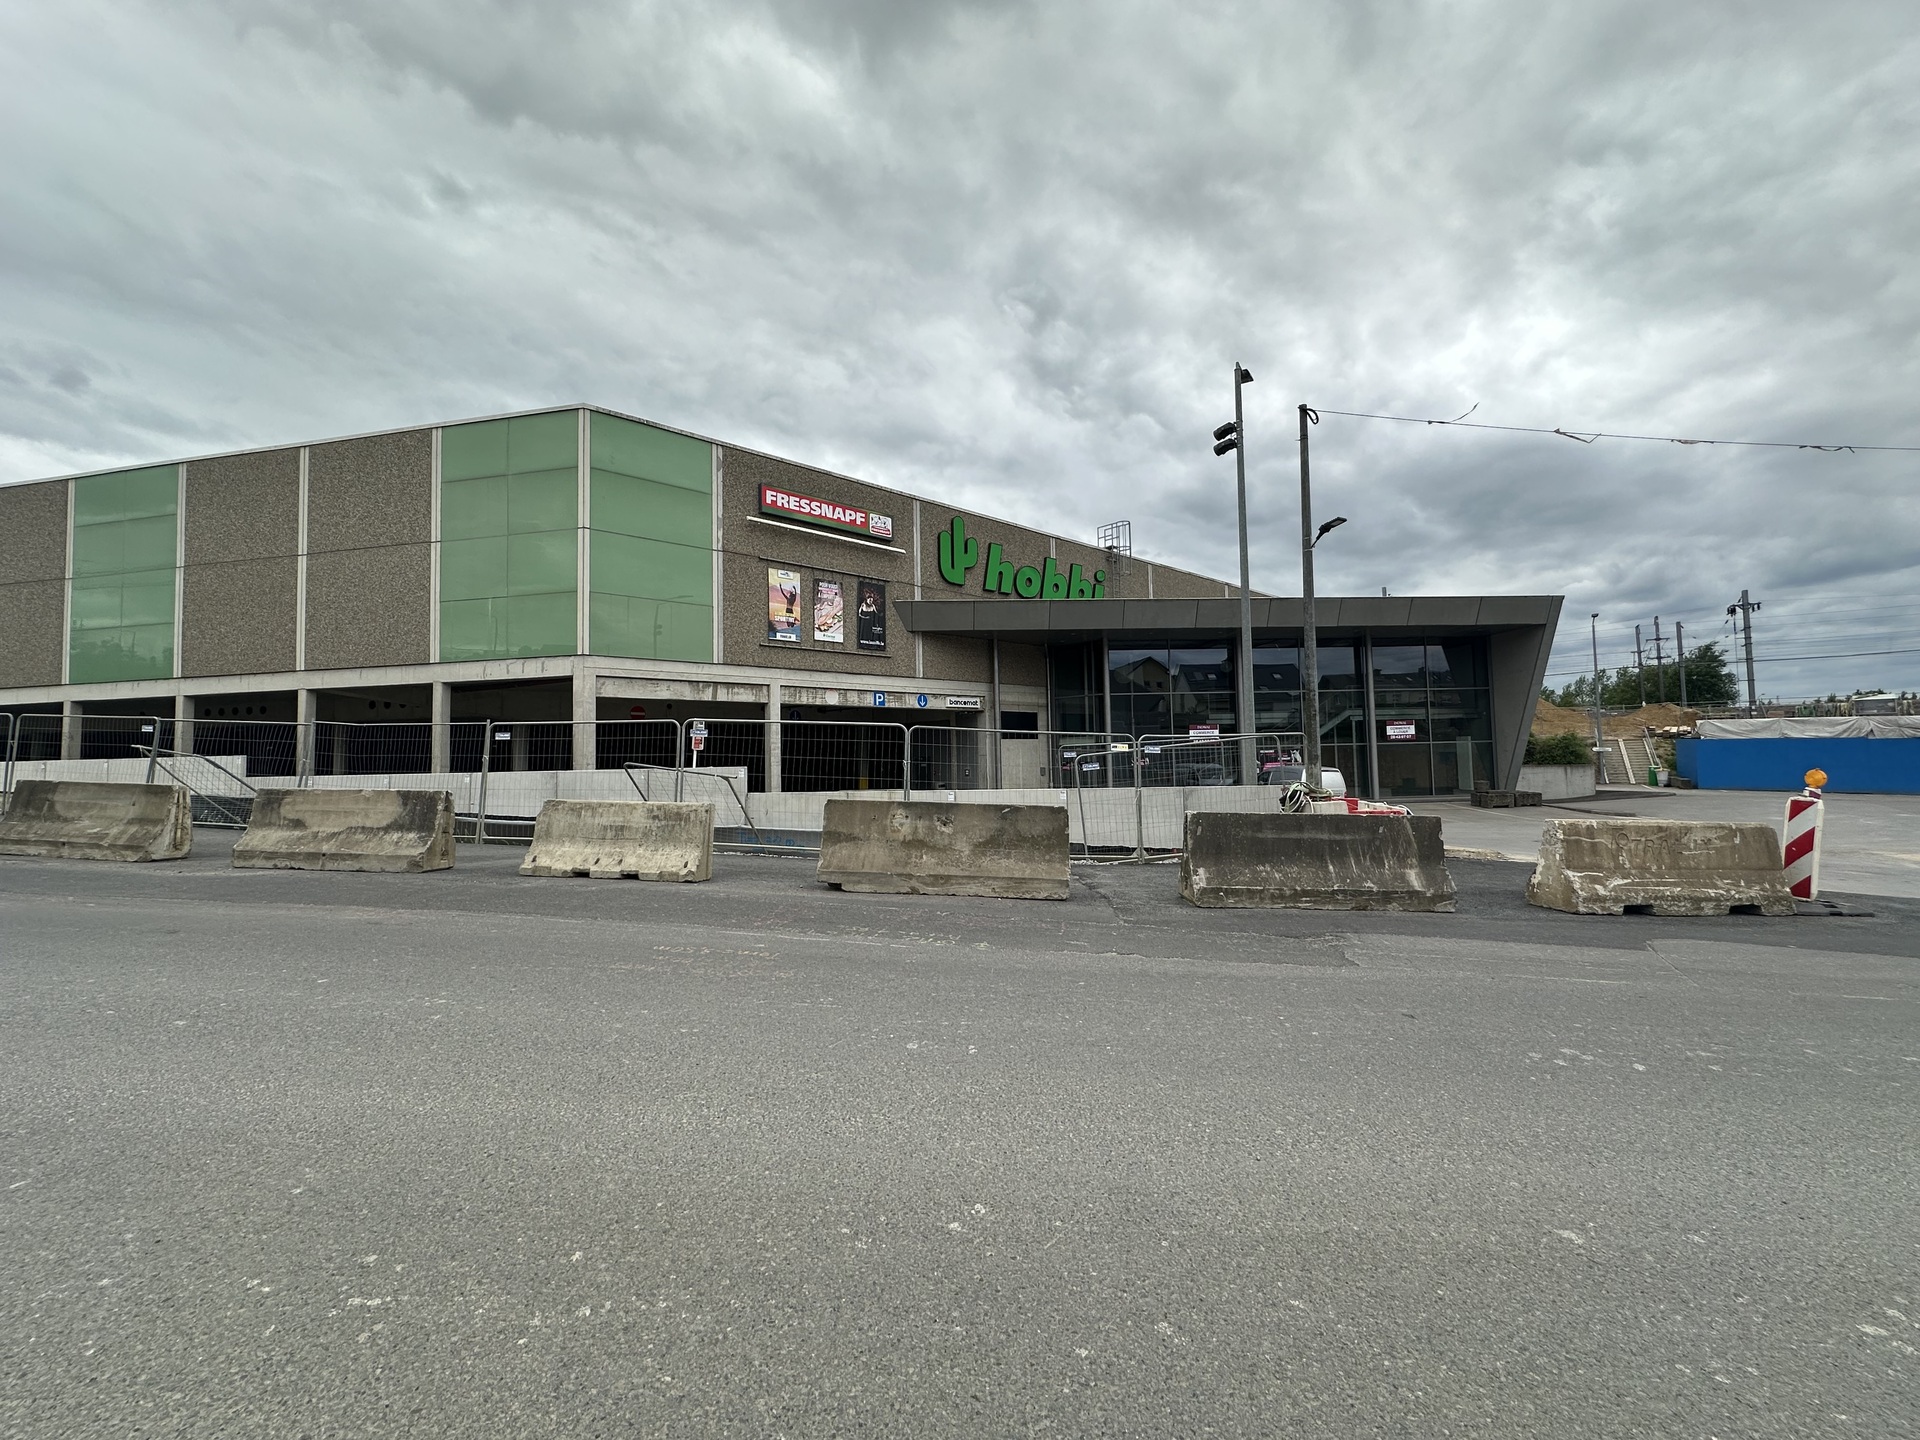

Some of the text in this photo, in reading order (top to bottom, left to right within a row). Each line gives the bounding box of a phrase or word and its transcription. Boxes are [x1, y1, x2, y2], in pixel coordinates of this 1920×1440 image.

[766, 490, 865, 525] FRESSNAPF
[984, 542, 1106, 599] hobbi
[875, 694, 884, 705] P
